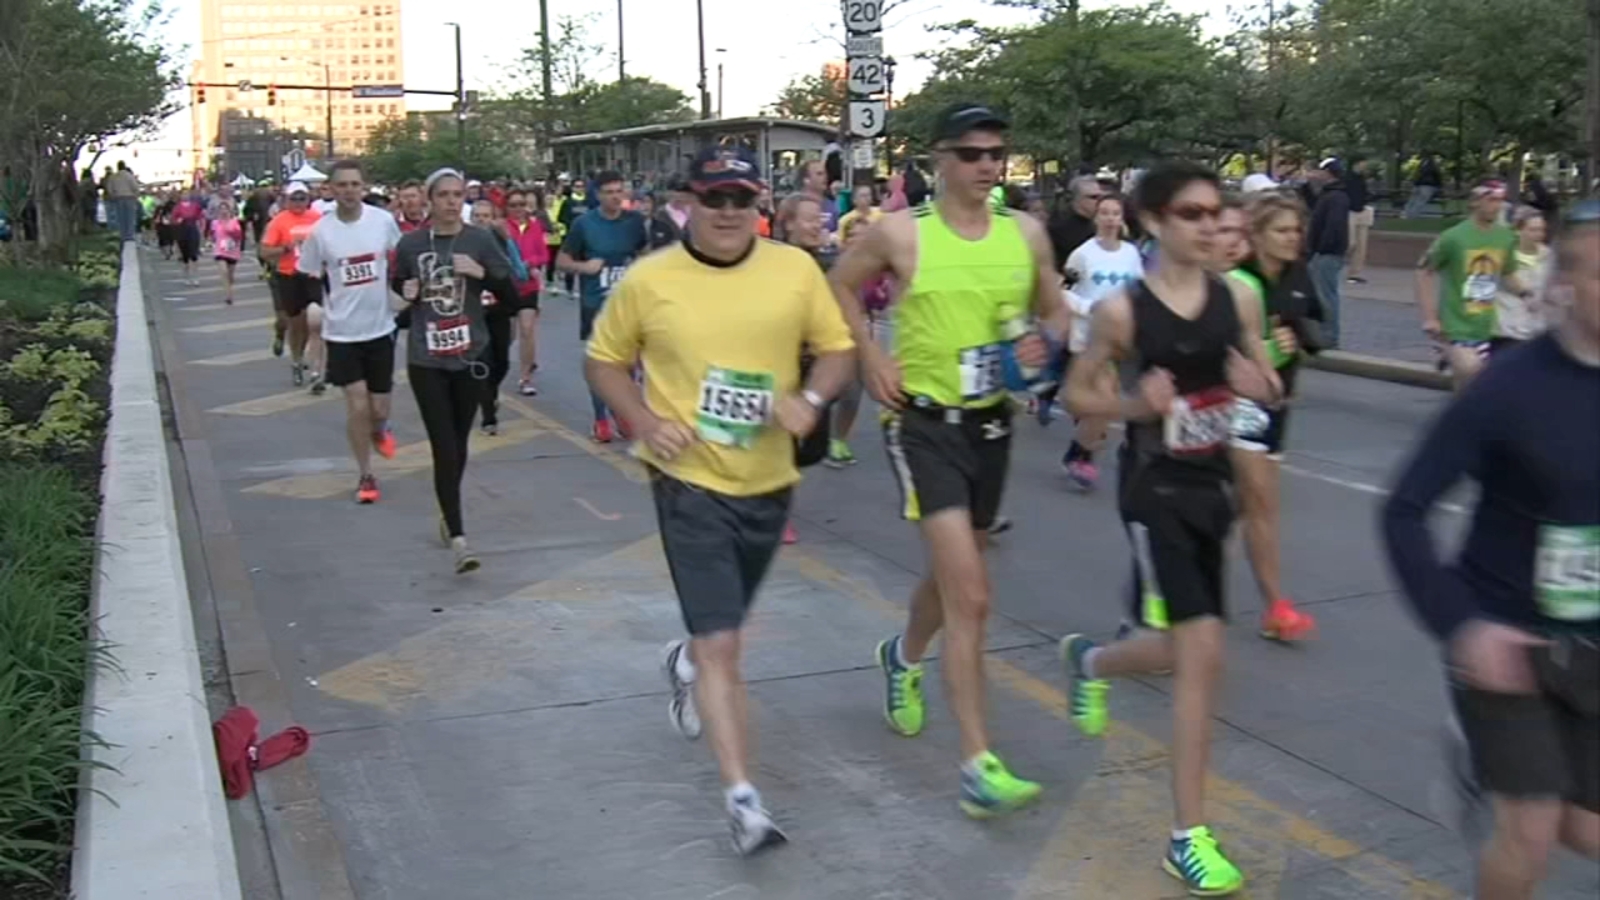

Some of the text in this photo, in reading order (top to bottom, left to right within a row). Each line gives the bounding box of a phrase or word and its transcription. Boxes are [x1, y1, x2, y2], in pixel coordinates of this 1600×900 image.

[849, 2, 877, 22] 20
[852, 64, 880, 85] 42
[860, 107, 875, 129] 3
